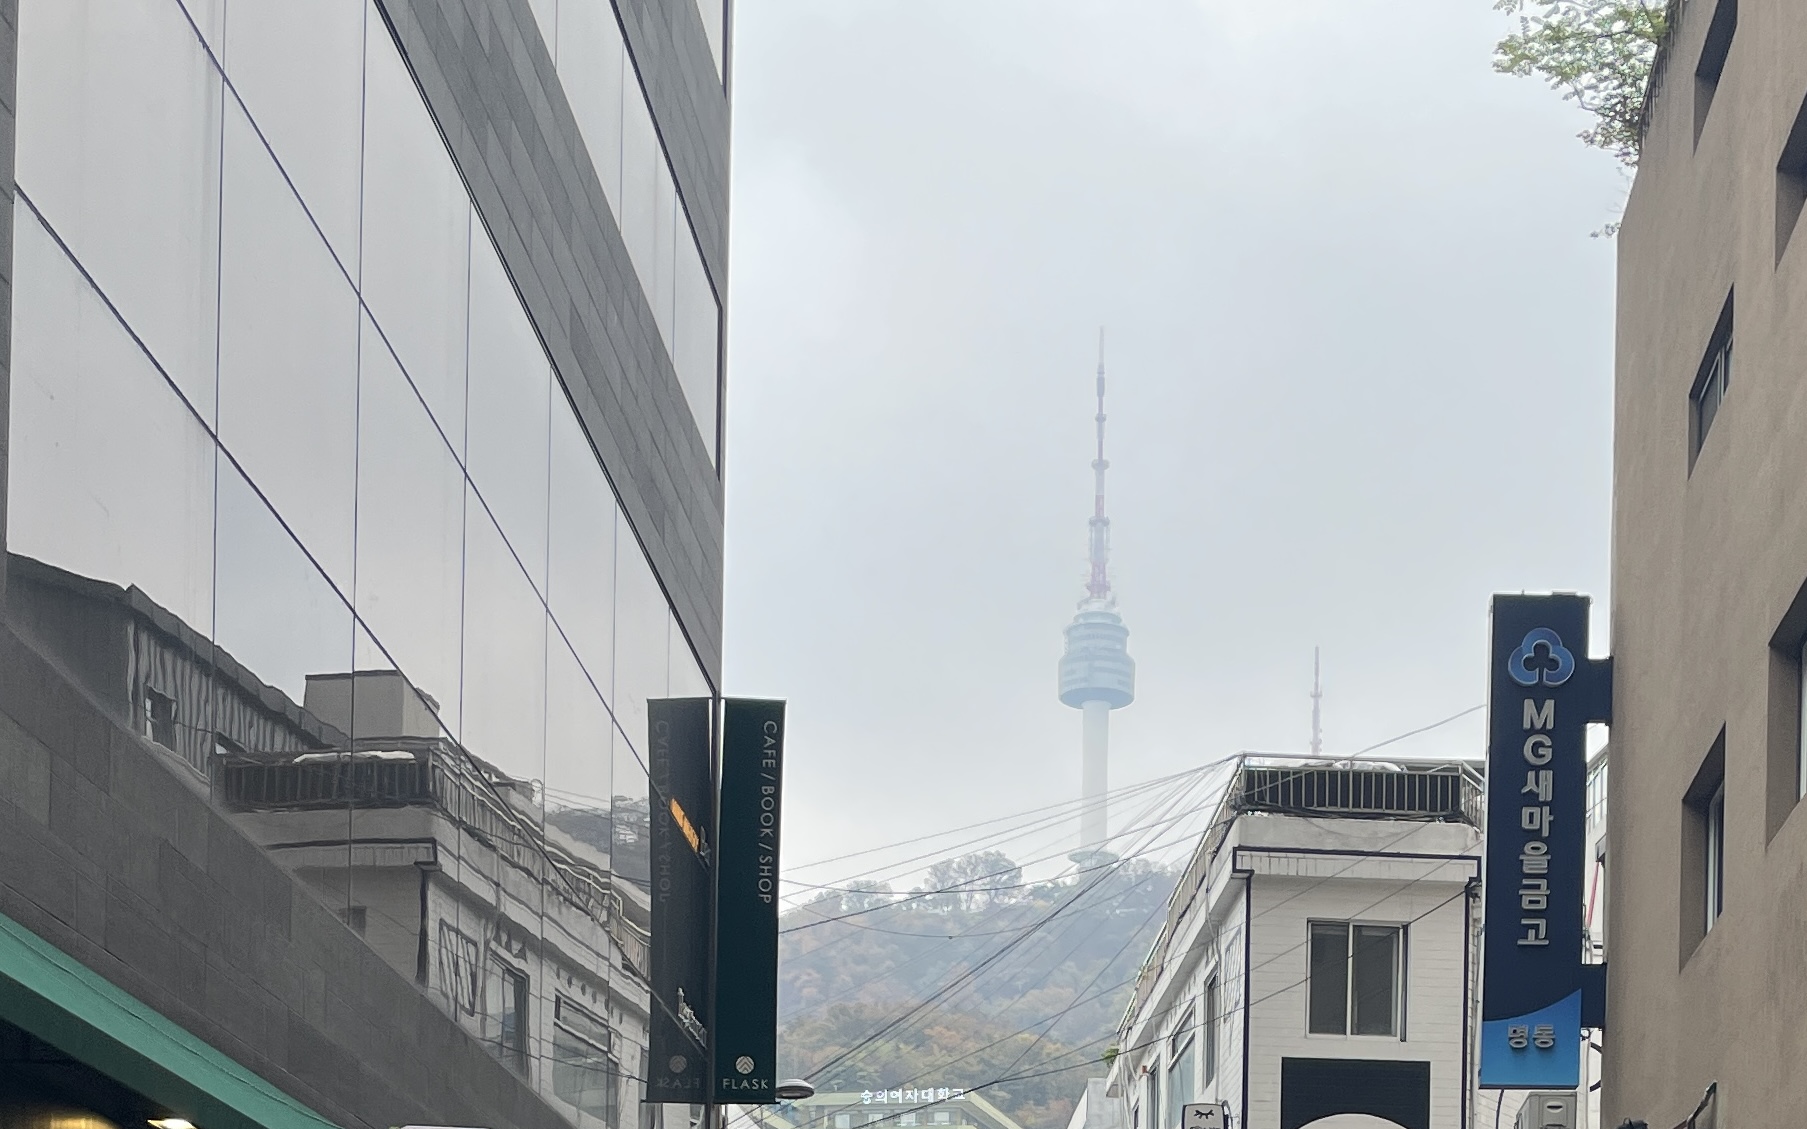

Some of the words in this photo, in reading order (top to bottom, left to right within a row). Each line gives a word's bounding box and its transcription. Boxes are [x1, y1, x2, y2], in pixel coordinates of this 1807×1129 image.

[763, 720, 778, 768] CAFE
[759, 785, 775, 838] BOOK
[1517, 698, 1555, 946] MG새마을금고
[758, 854, 773, 904] SHOP
[1507, 1024, 1556, 1050] 명동
[722, 1078, 769, 1090] FLASK
